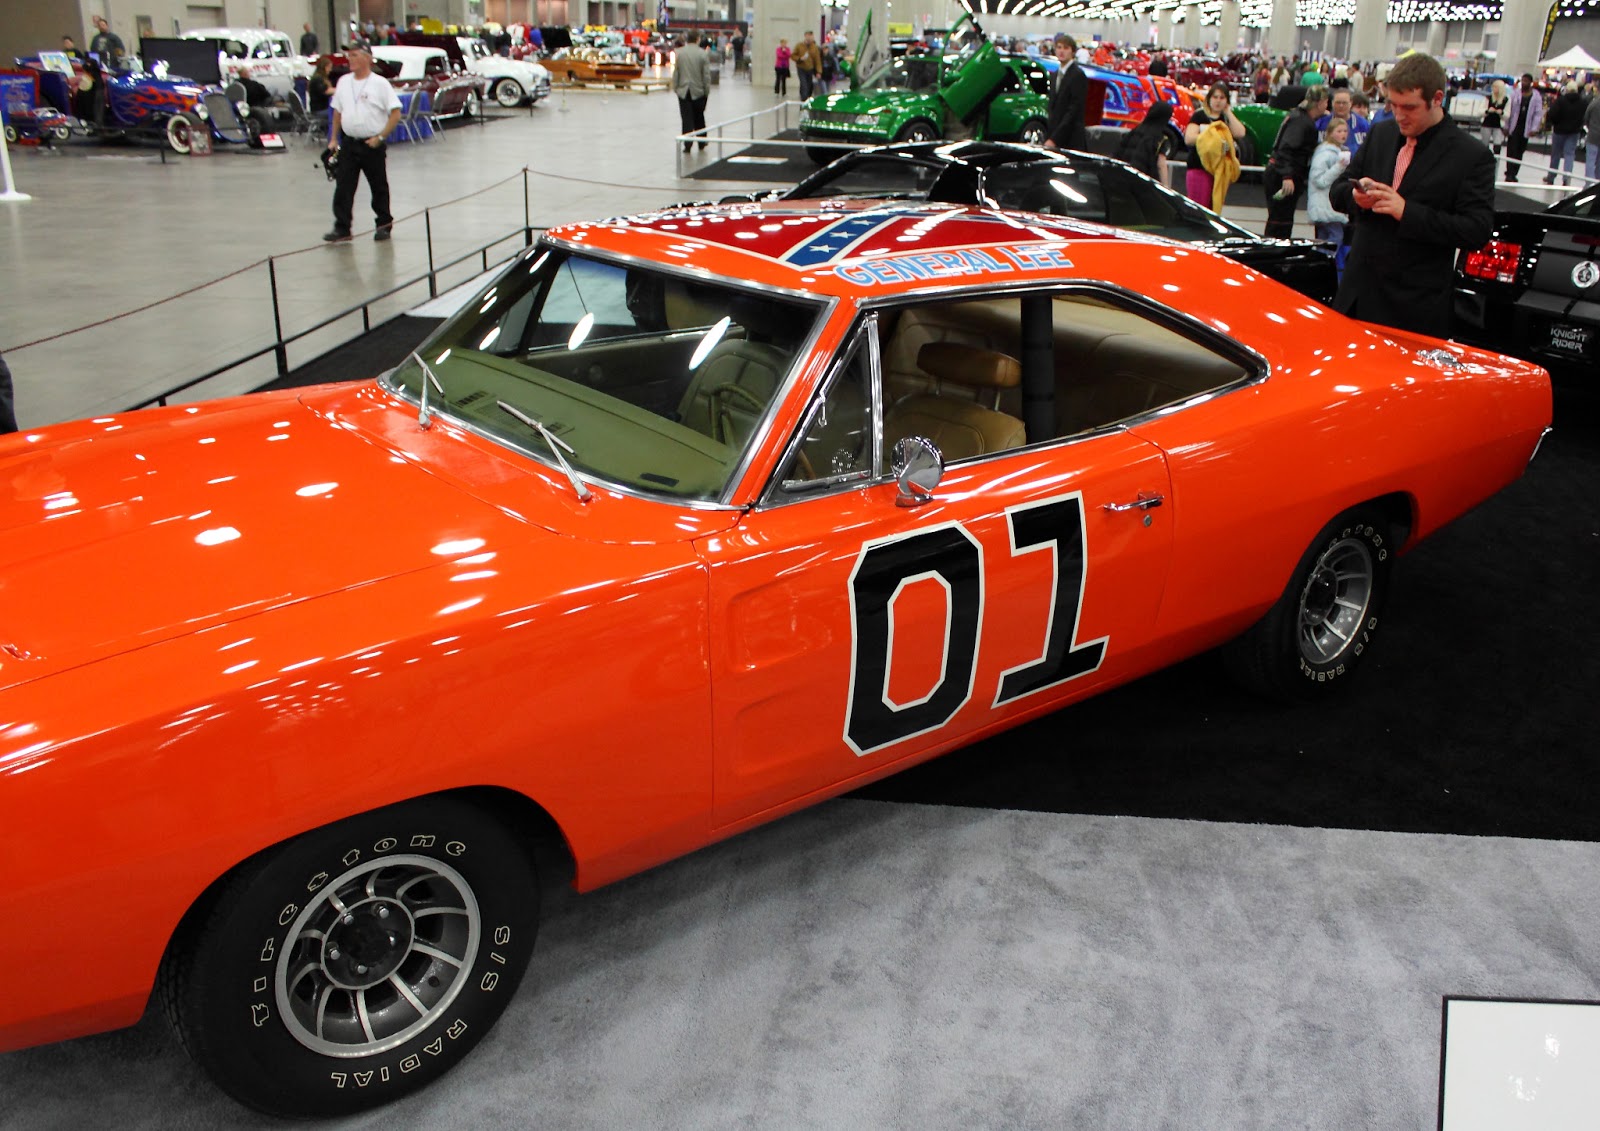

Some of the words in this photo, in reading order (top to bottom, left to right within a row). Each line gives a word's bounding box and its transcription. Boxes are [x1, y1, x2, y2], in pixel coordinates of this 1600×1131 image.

[832, 247, 1015, 287] GENERAL
[1012, 244, 1075, 271] LEE
[1550, 327, 1587, 343] KNIGHT
[842, 490, 1110, 757] 01
[1299, 657, 1345, 682] RADIAL
[330, 1018, 468, 1089] RADIAL
